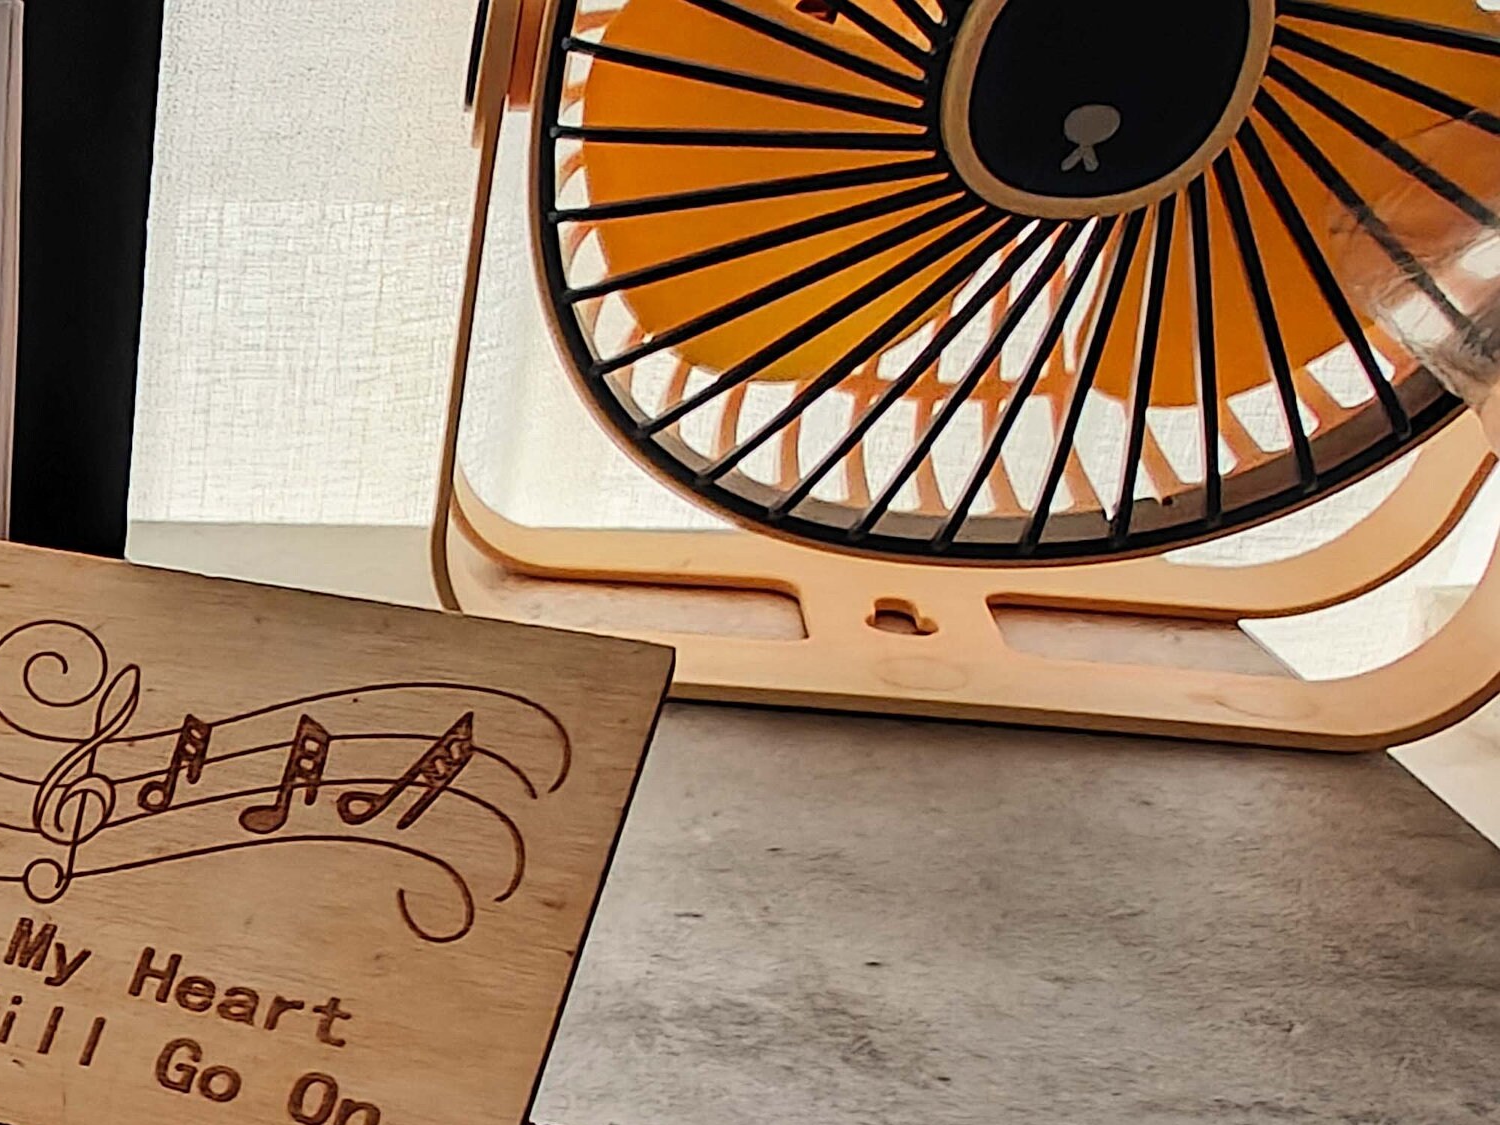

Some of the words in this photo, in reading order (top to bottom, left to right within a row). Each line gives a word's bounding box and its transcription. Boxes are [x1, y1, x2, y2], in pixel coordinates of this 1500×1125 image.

[3, 916, 92, 987] My
[128, 946, 352, 1048] Heart
[155, 1037, 242, 1103] Go
